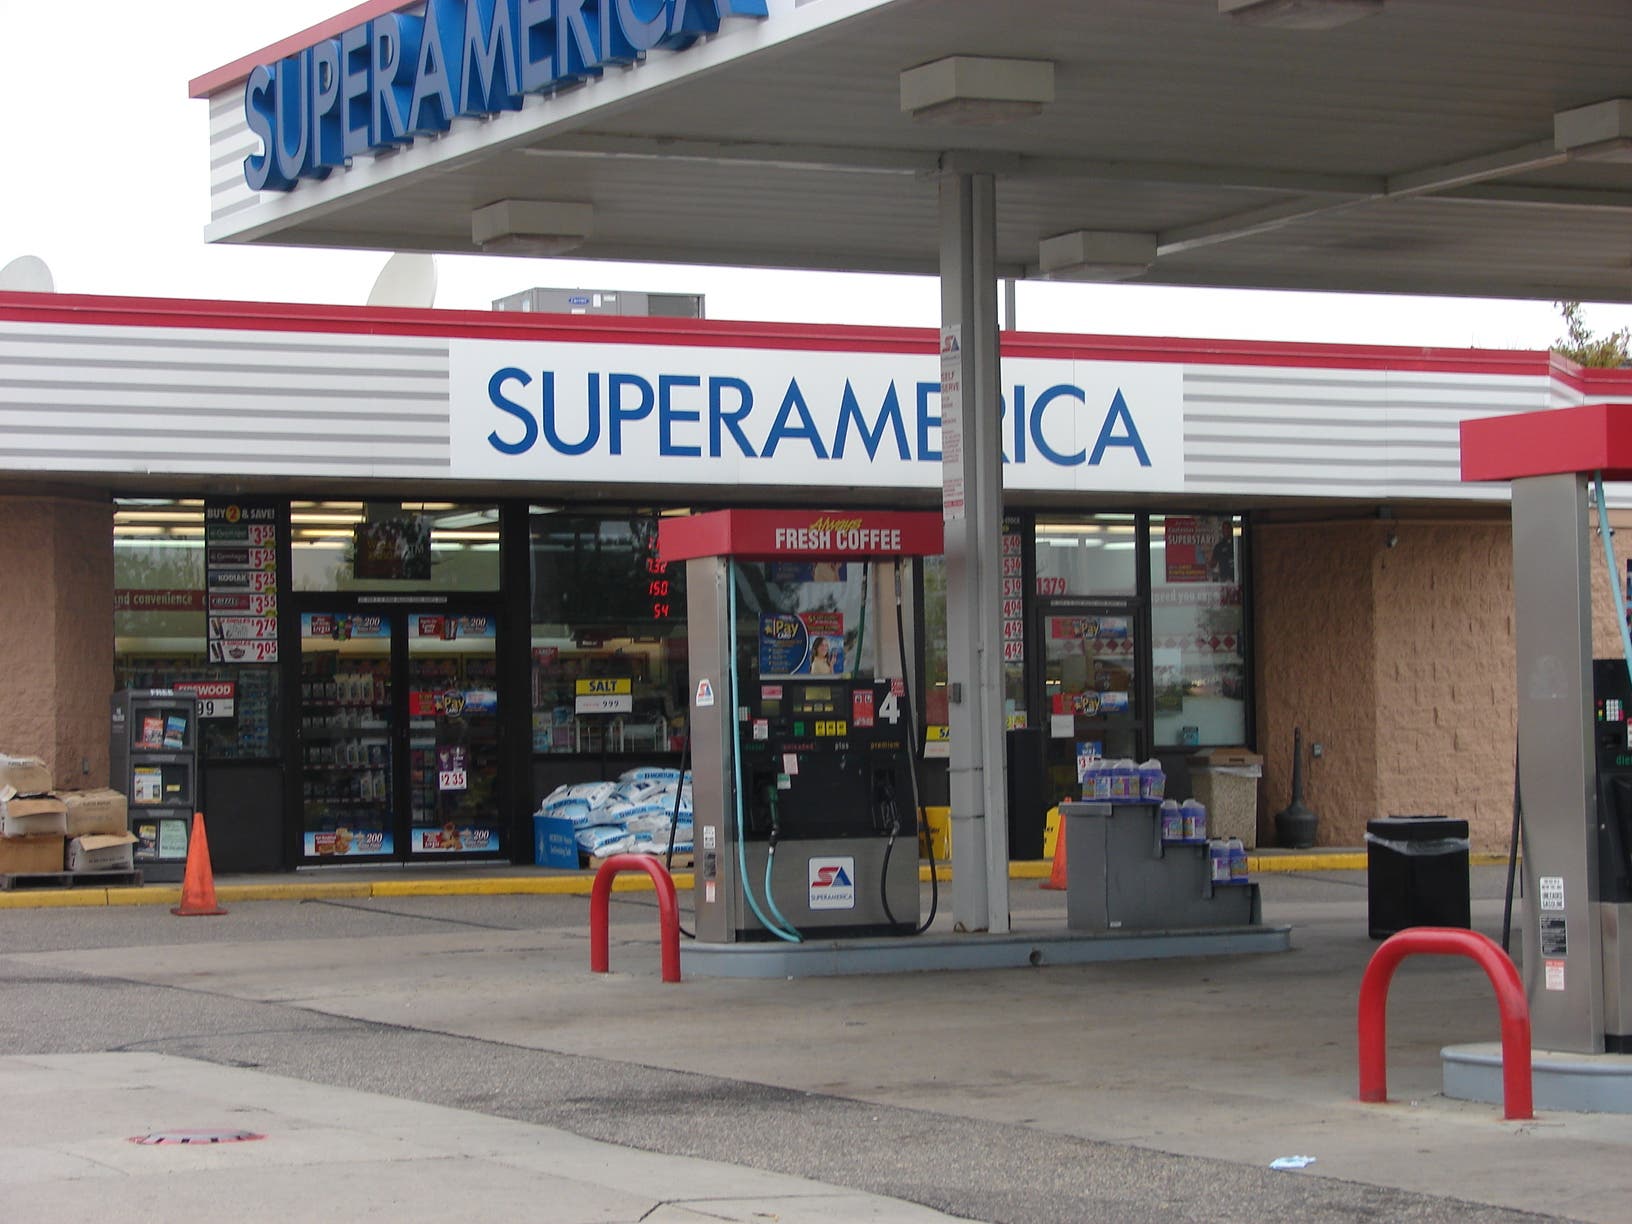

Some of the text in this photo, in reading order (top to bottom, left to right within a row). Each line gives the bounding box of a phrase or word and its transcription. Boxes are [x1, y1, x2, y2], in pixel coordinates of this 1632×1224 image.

[486, 366, 1152, 467] SUPERAMEICA
[207, 506, 275, 520] BUY 2 & SAVE!
[810, 517, 862, 532] Always
[775, 528, 901, 550] FRESH COFFEE
[1036, 577, 1067, 596] 1379
[133, 592, 193, 606] convenience
[776, 619, 799, 639] Pay
[589, 680, 618, 692] SALT
[445, 697, 465, 713] Pay
[878, 689, 901, 724] 4
[1082, 697, 1100, 714] Pay
[811, 866, 853, 888] SA
